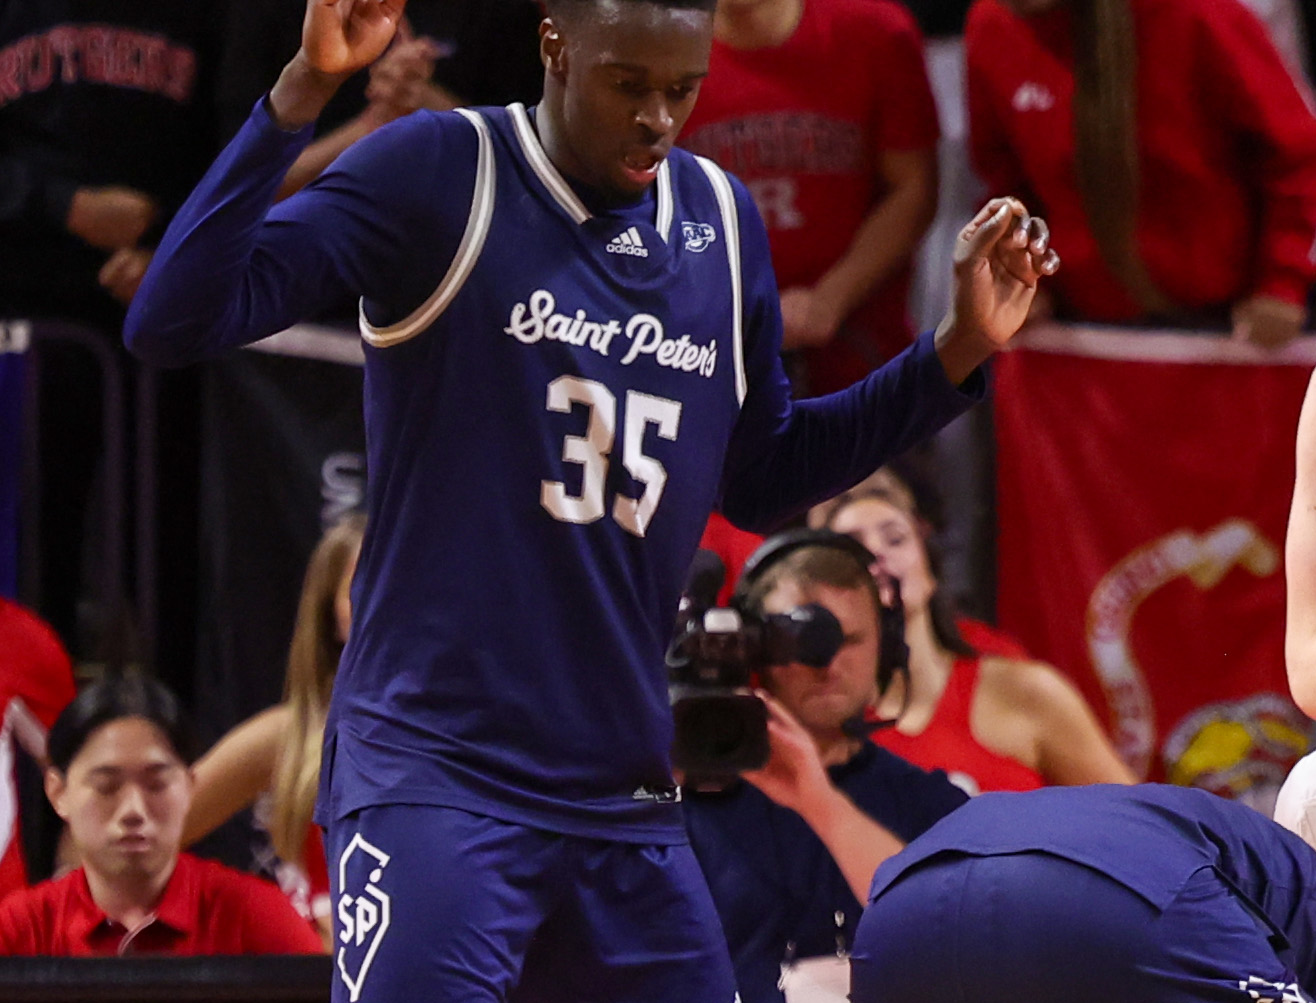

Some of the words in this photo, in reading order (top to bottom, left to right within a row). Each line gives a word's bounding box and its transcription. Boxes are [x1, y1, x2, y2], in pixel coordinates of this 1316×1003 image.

[606, 243, 649, 258] adidas
[504, 290, 622, 357] Saint
[620, 313, 718, 378] Peter's
[540, 374, 683, 538] 35
